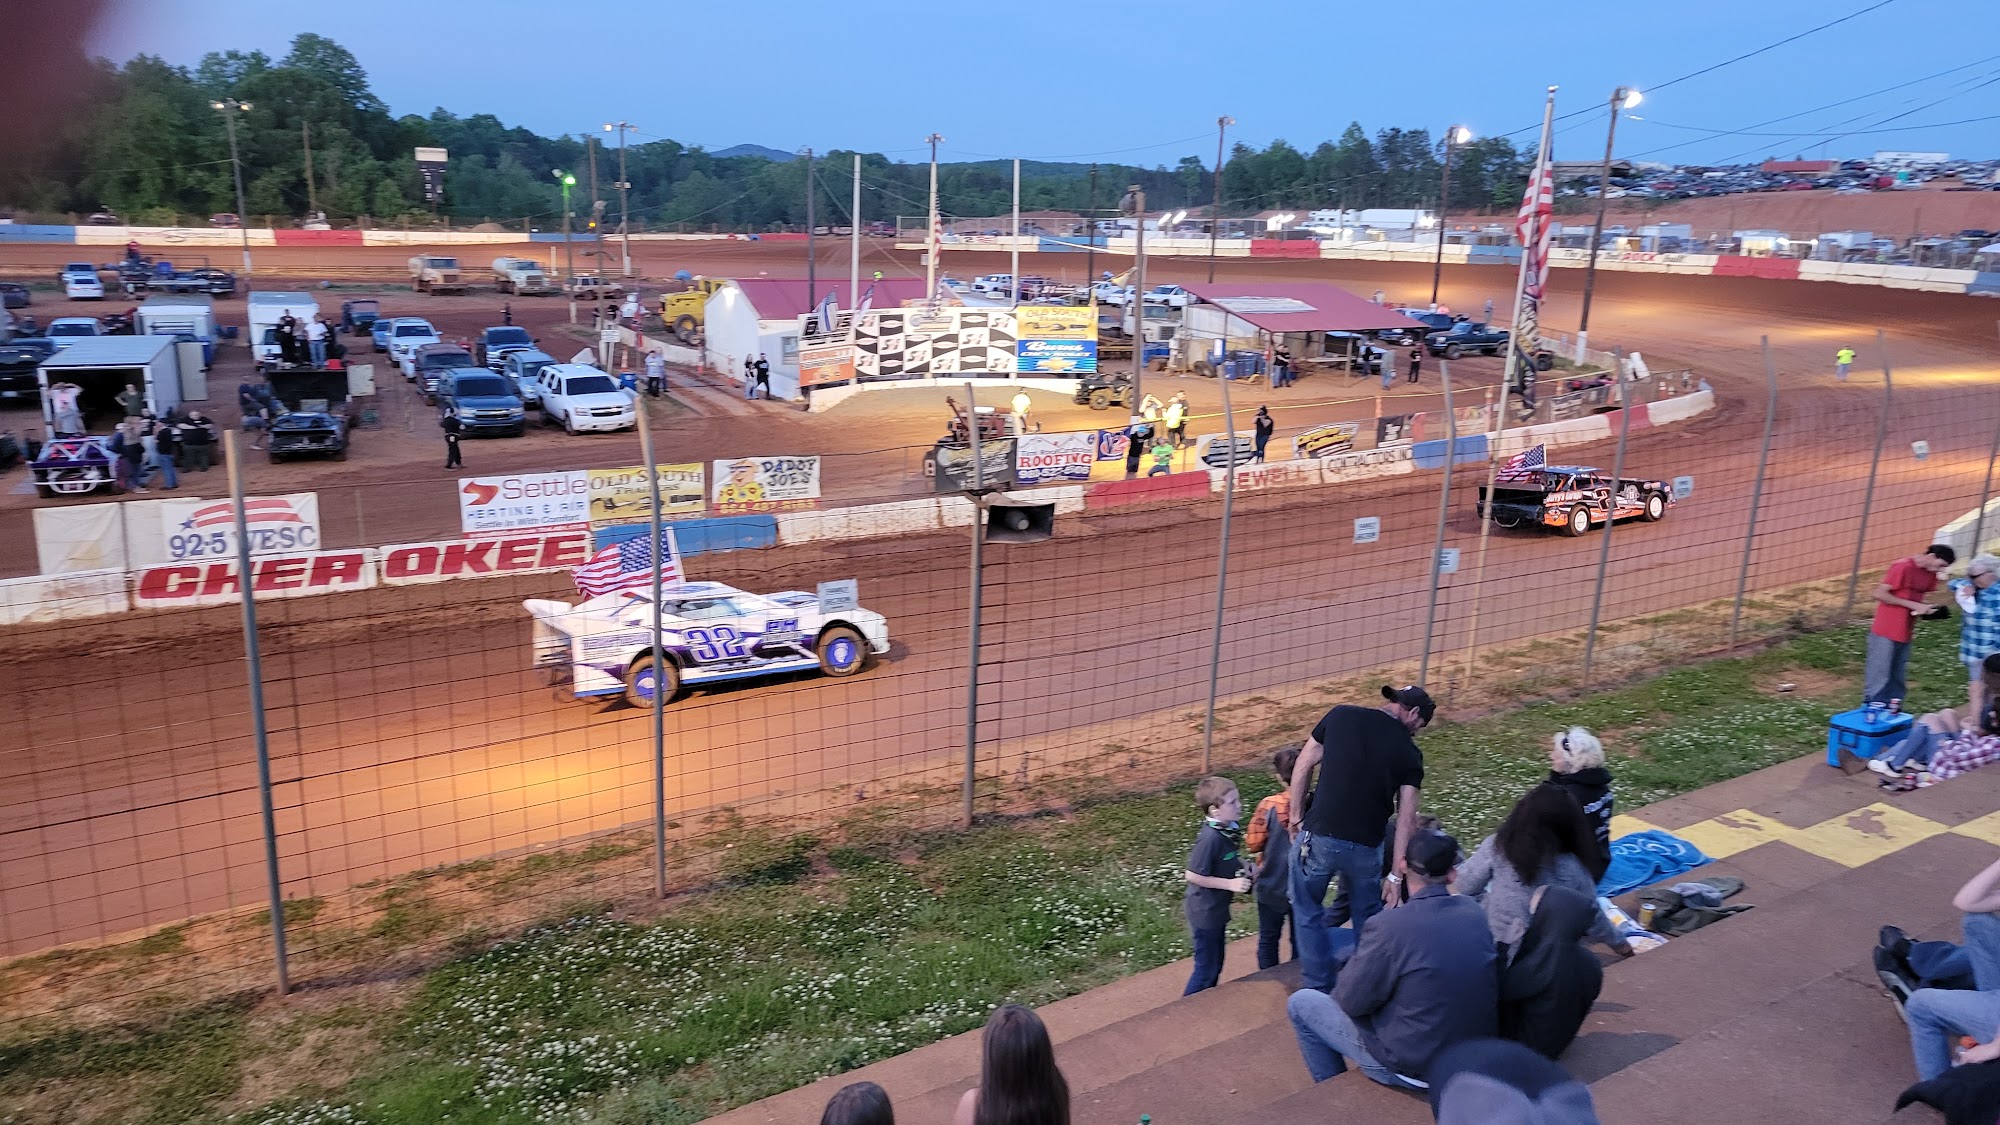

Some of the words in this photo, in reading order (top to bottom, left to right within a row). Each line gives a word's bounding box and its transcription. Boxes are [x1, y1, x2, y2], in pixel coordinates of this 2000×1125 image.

[761, 459, 816, 473] DADDY
[1019, 453, 1092, 468] ROOFING
[591, 473, 630, 490] OLD
[637, 469, 703, 483] SUTH
[1222, 464, 1310, 489] EWELL
[503, 474, 587, 500] Settle
[613, 483, 680, 495] TRAIERS
[467, 505, 533, 519] HEATING
[560, 501, 584, 512] AIR
[685, 625, 748, 662] 32
